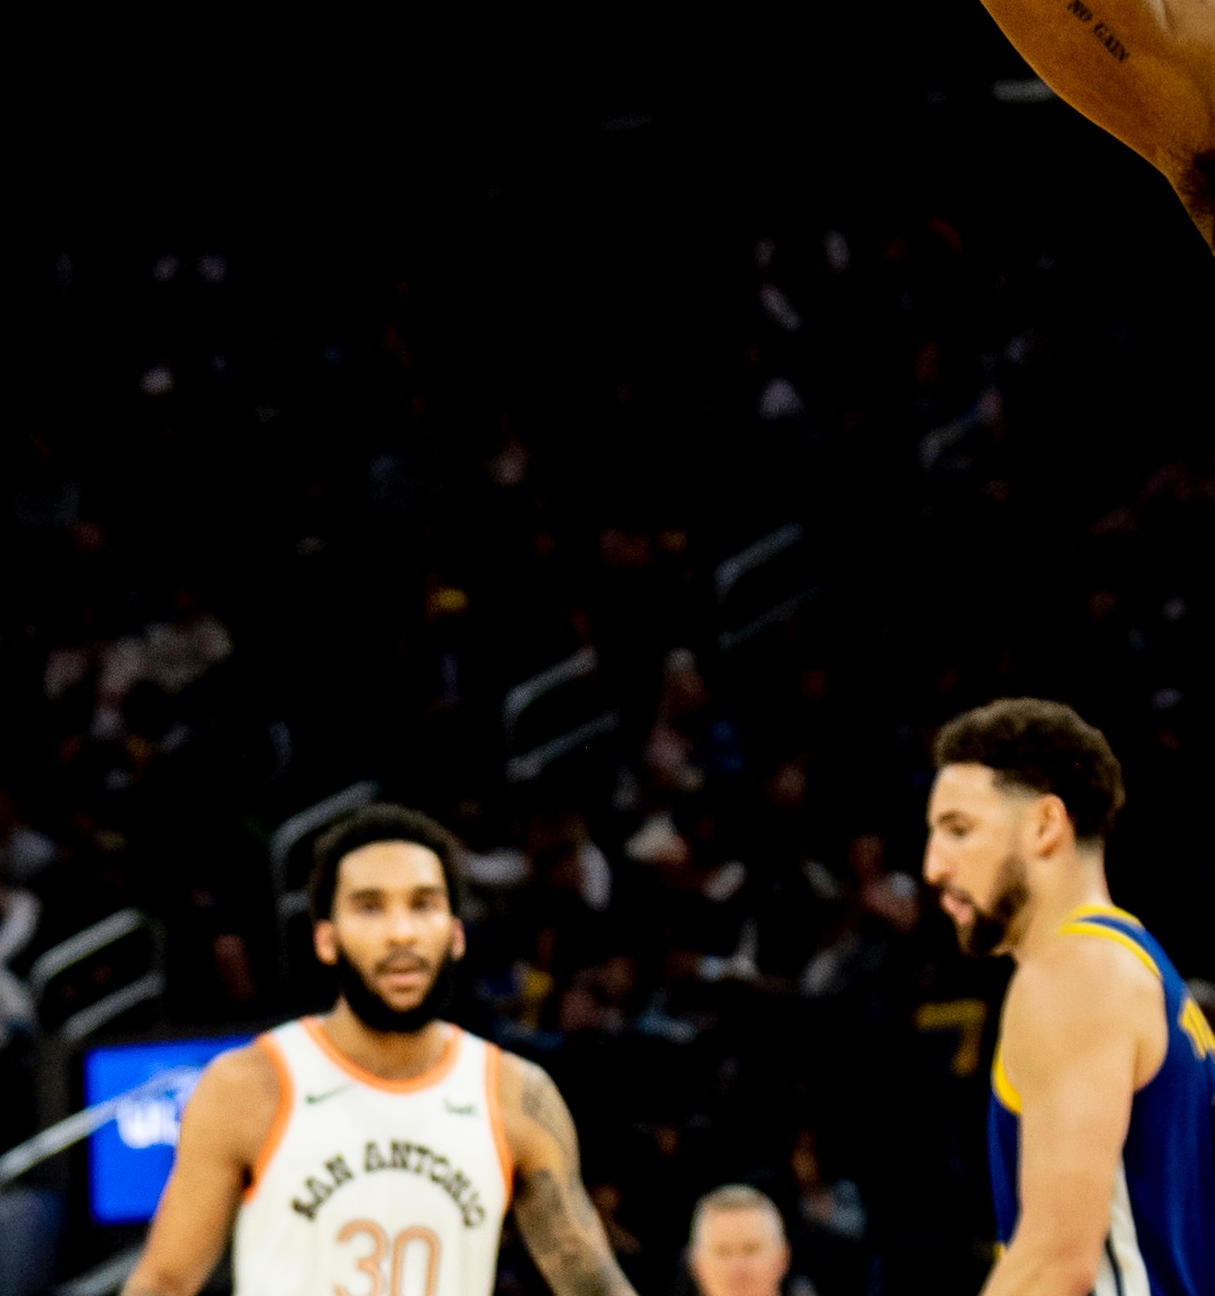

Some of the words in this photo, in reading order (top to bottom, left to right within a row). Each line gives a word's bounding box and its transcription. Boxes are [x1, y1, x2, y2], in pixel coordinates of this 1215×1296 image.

[1092, 22, 1130, 62] GAIN
[290, 1153, 356, 1223] SAN
[363, 1139, 486, 1230] ANTONIO
